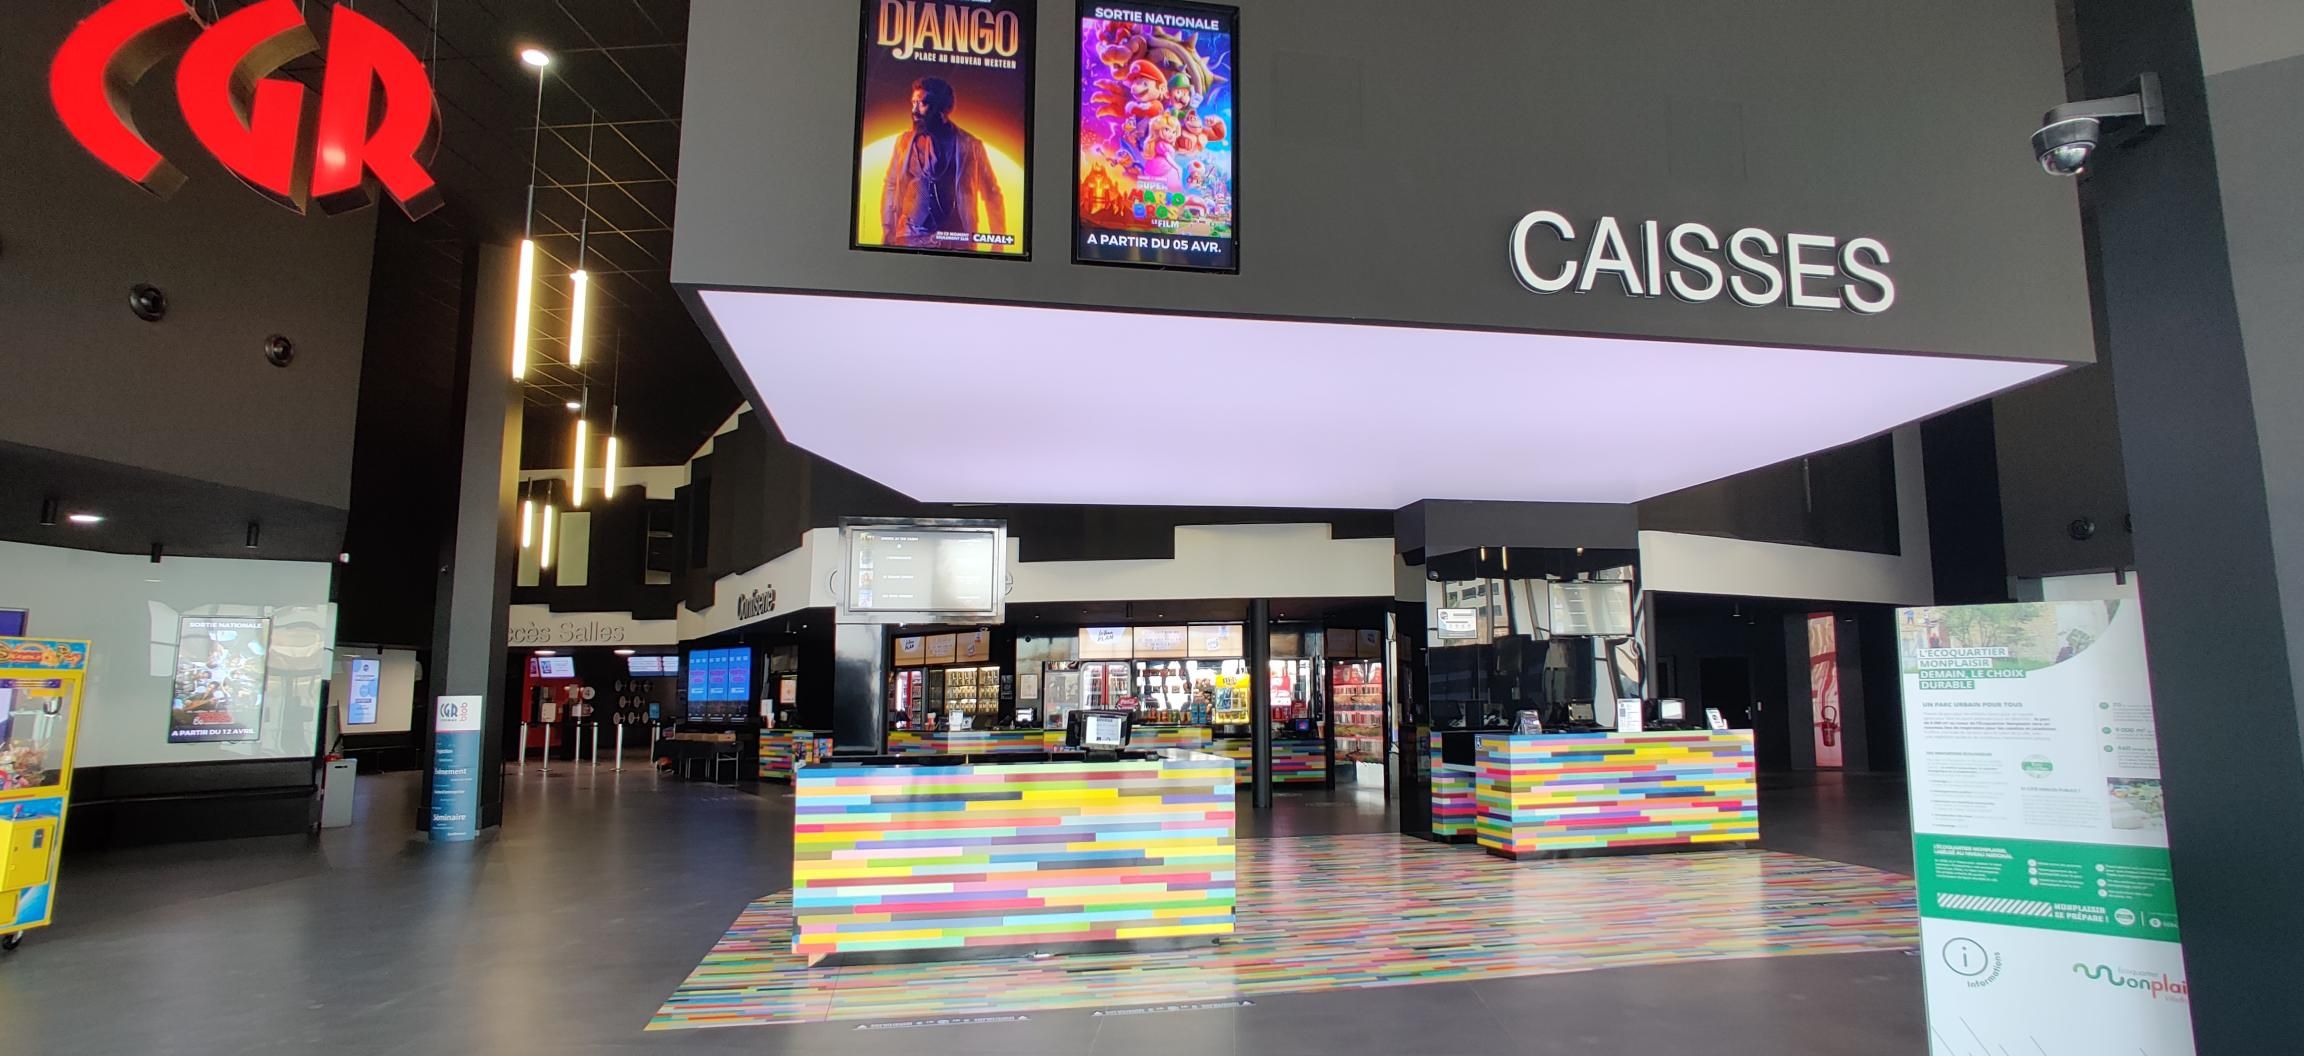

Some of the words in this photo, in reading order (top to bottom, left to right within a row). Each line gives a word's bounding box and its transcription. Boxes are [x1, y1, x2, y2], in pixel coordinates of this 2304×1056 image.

[1095, 7, 1142, 23] SORTIE
[1145, 13, 1219, 31] NATIONALE
[877, 0, 1019, 60] DJANGO
[914, 51, 936, 62] PLACE
[939, 54, 948, 63] AU
[951, 55, 982, 66] NOUVEAU
[984, 58, 1017, 69] WESTERN
[50, 0, 436, 204] CGR
[1129, 188, 1185, 207] MARIO
[1158, 220, 1179, 228] FILM
[973, 234, 1014, 244] CANAL+
[1087, 233, 1097, 245] A
[1100, 234, 1148, 248] PARTIR
[1151, 239, 1170, 249] DU
[1173, 240, 1188, 250] 05
[1191, 241, 1222, 253] AVR.
[1509, 210, 1895, 316] CAISSES
[560, 621, 626, 643] Salles
[1920, 659, 1989, 668] MONPLAISIR
[1920, 669, 1968, 679] DEMAIN,
[1971, 669, 1985, 678] LE
[1988, 669, 2024, 678] CHOIX
[1921, 680, 1973, 689] DURABLE
[440, 703, 458, 717] CGR
[2054, 903, 2106, 914] MONPLAISIR
[1966, 952, 2003, 988] Informations
[2073, 963, 2188, 999] Monplai
